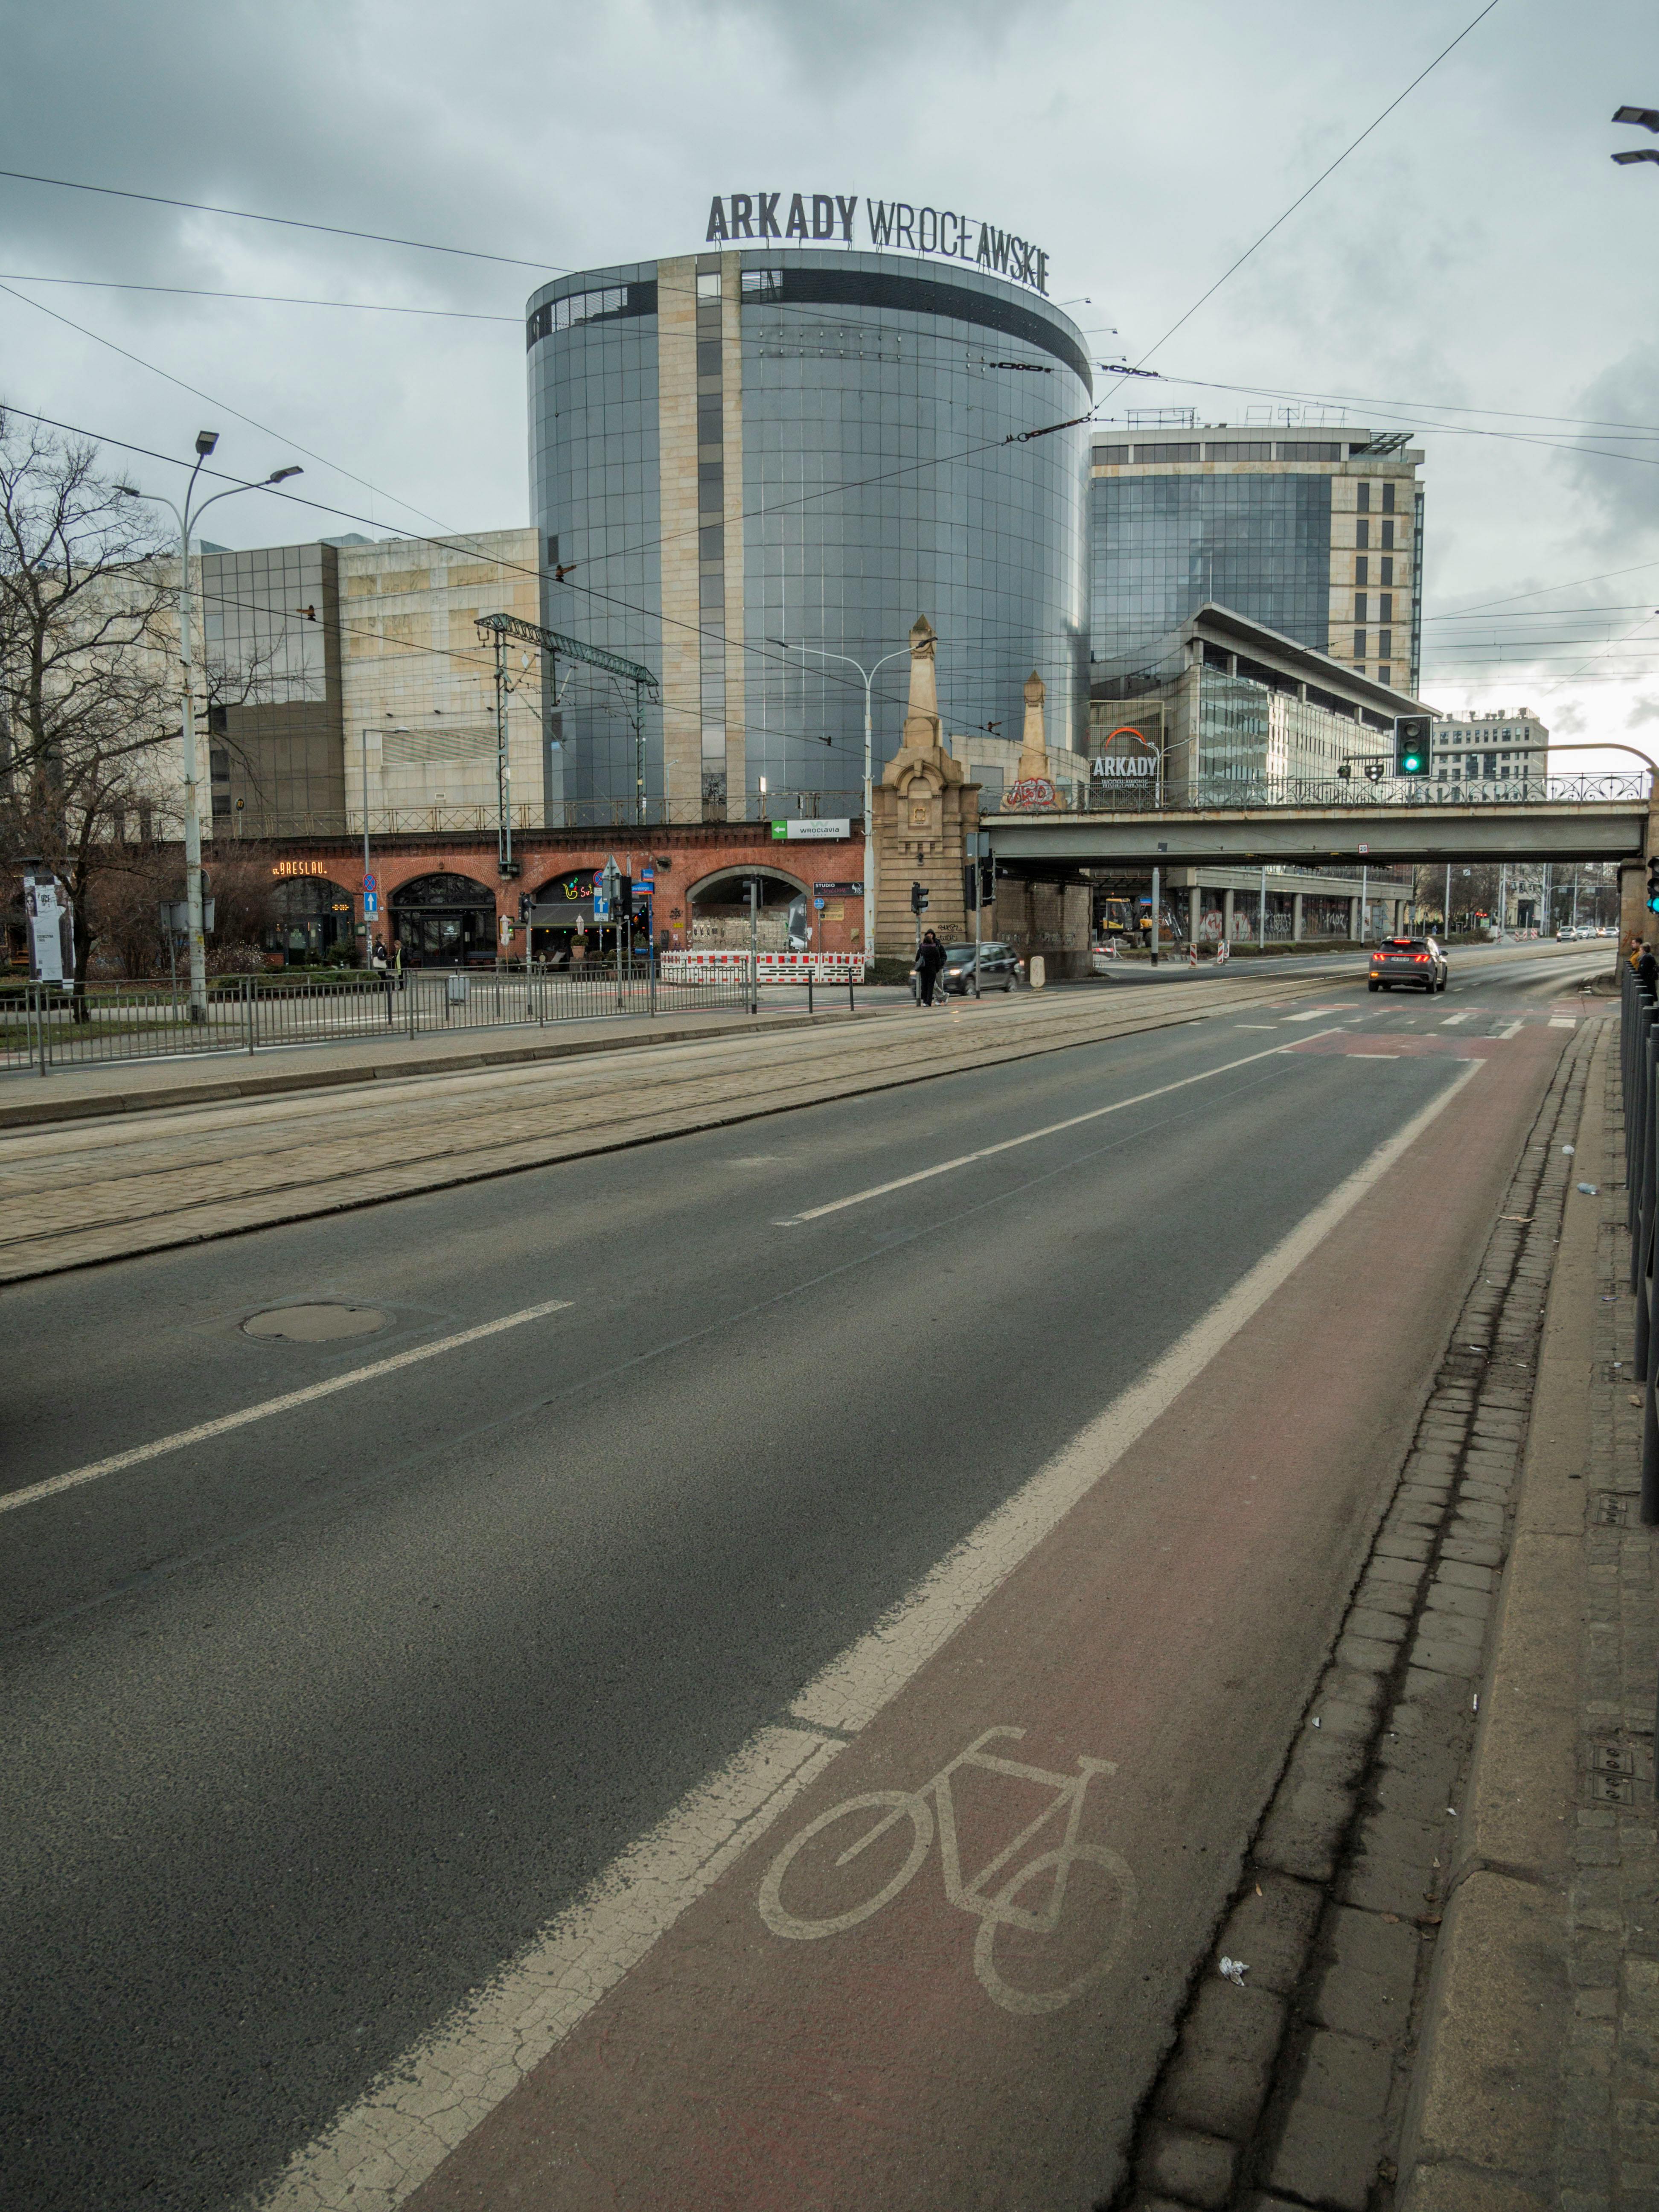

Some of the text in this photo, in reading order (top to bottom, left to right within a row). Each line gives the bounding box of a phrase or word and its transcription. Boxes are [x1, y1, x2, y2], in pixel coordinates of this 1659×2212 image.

[706, 192, 1050, 297] ARKADY WROCŁAWSKIE
[1093, 757, 1157, 777] ARKADY
